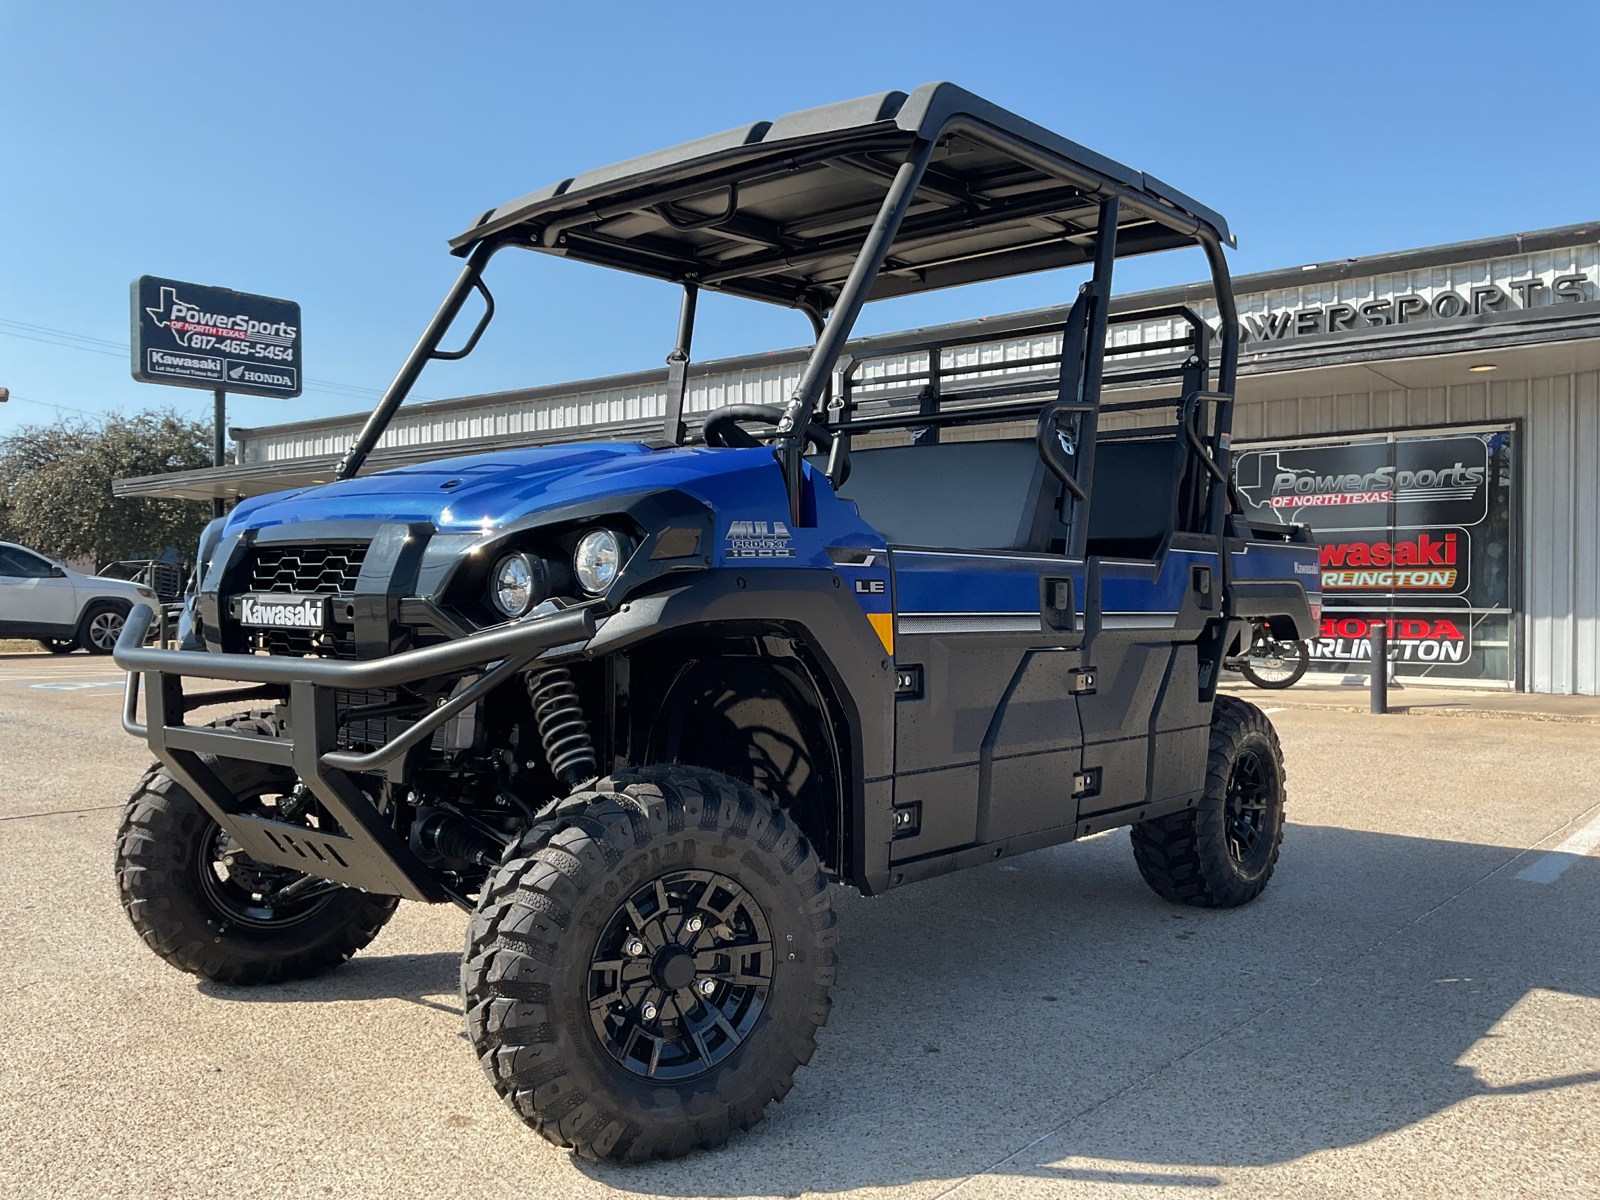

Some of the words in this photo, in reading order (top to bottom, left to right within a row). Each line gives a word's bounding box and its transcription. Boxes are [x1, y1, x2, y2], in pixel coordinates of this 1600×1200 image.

[170, 304, 297, 339] PowerSports
[170, 321, 184, 330] OF
[184, 323, 217, 335] NORTH
[218, 328, 246, 339] TEXAS
[191, 334, 294, 362] 817-465-5454
[152, 351, 221, 371] Kawasaki
[244, 370, 293, 386] HONDA
[1272, 462, 1486, 496] PowerSports
[1272, 496, 1291, 507] OF
[1293, 493, 1343, 506] NORTH
[1344, 491, 1391, 503] TEXAS
[725, 520, 793, 540] MULE
[733, 549, 790, 557] 1000
[1319, 532, 1457, 567] wasaki
[1293, 561, 1319, 575] Kawasaki
[855, 581, 885, 593] LE
[1321, 571, 1450, 586] RLINGTON
[242, 599, 322, 626] Kawasaki
